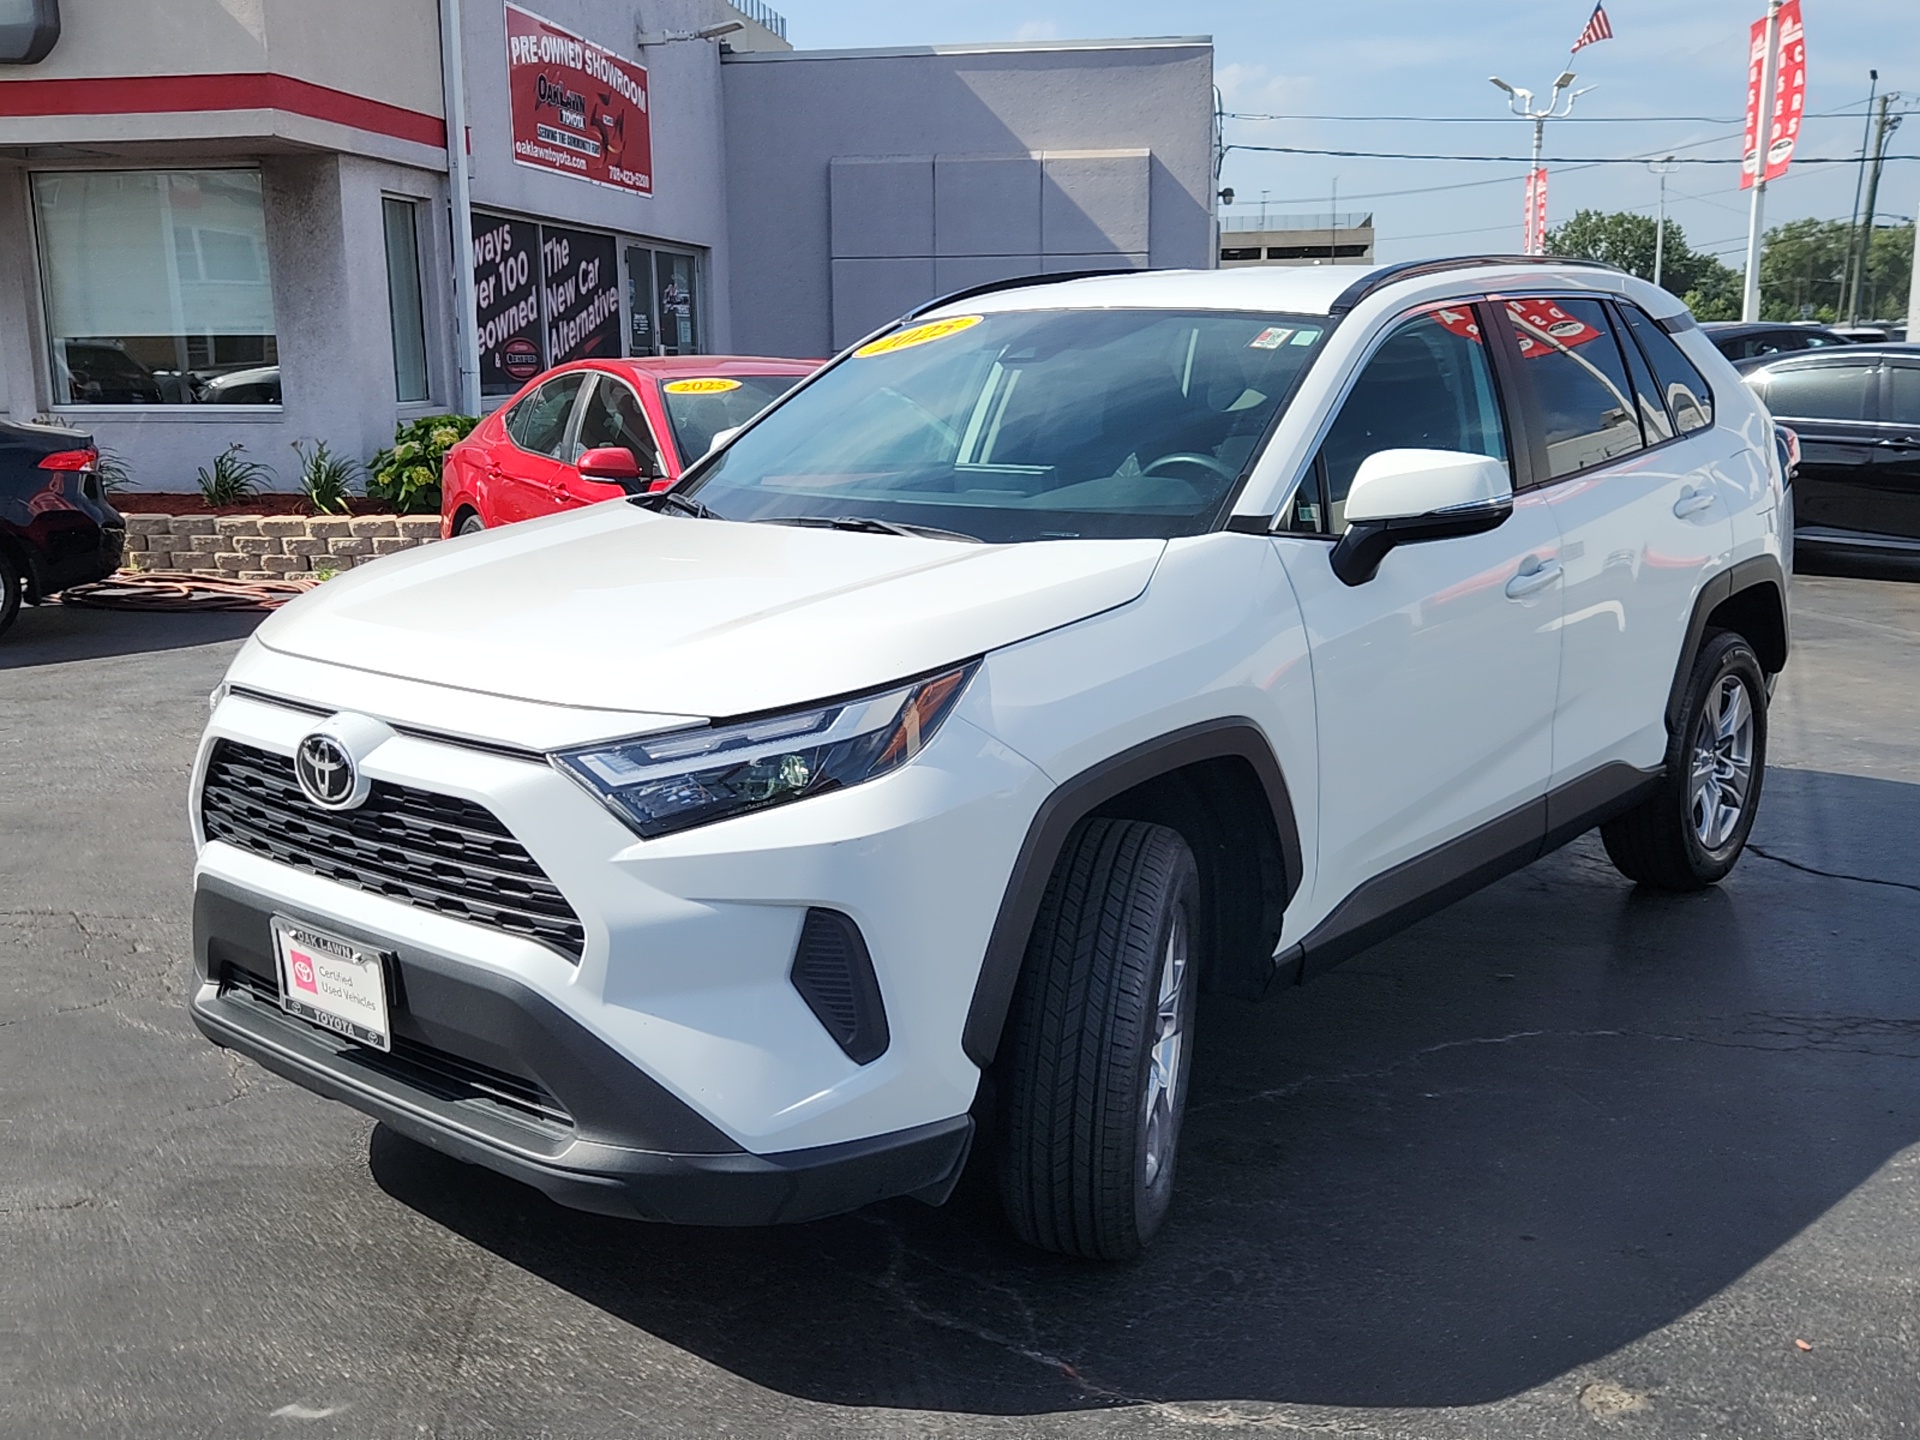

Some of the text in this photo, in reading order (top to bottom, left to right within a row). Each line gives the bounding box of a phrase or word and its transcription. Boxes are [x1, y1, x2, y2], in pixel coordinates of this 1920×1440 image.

[510, 35, 646, 113] PRE-OWNED SHOWROOM
[1787, 45, 1804, 135] CARS
[561, 109, 585, 129] TOYOTA
[515, 140, 587, 170] oaklawntoyota.com
[474, 224, 511, 268] ways
[544, 237, 570, 278] The
[499, 251, 528, 297] 100
[547, 257, 599, 322] New Car
[478, 285, 538, 355] eowned
[551, 286, 619, 365] Alternative
[867, 319, 965, 354] 2025
[680, 380, 728, 391] 2025
[297, 930, 352, 959] OAK LAWN
[318, 966, 353, 987] Certified
[321, 981, 376, 1011] Used Vehicles
[314, 1009, 355, 1036] TOYOTA
